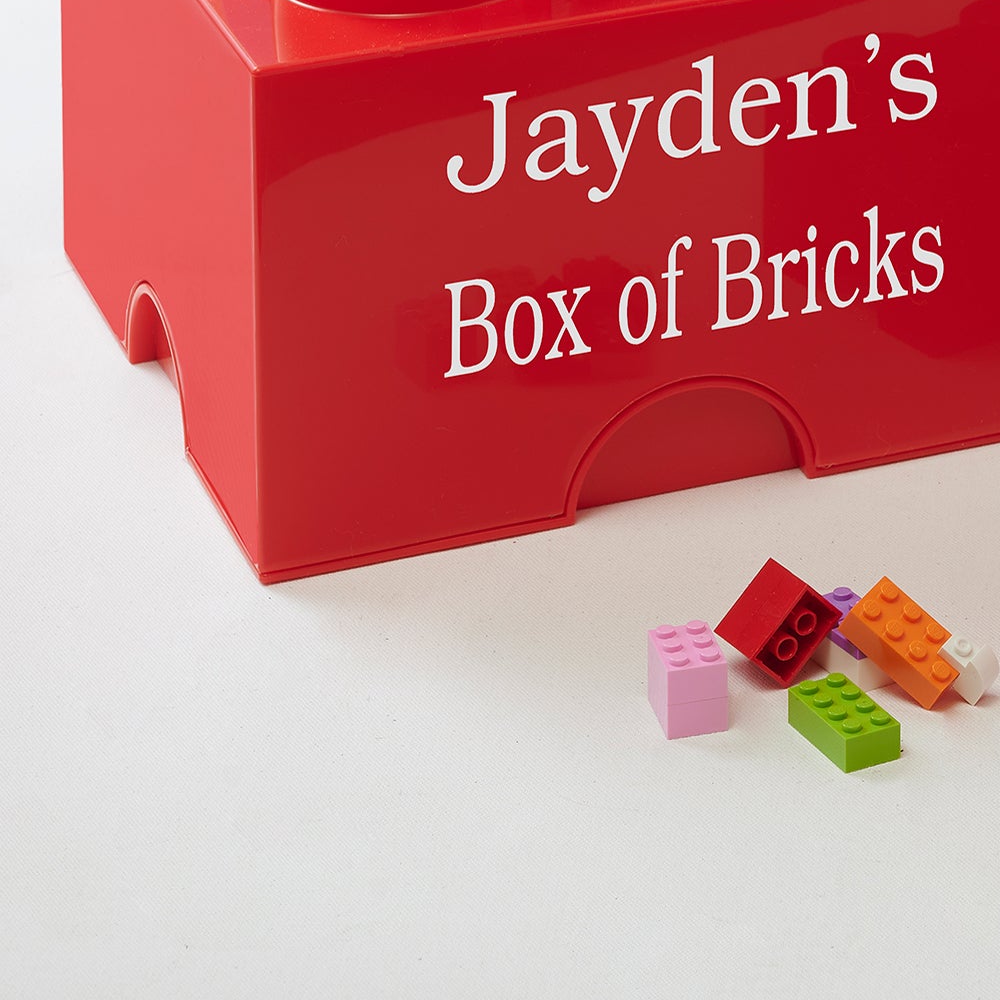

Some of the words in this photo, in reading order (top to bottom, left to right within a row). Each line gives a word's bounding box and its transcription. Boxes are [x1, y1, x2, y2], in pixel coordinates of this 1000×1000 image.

[446, 33, 939, 203] Jayden's
[443, 278, 593, 379] Box
[618, 235, 693, 345] of
[710, 205, 945, 331] Bricks
